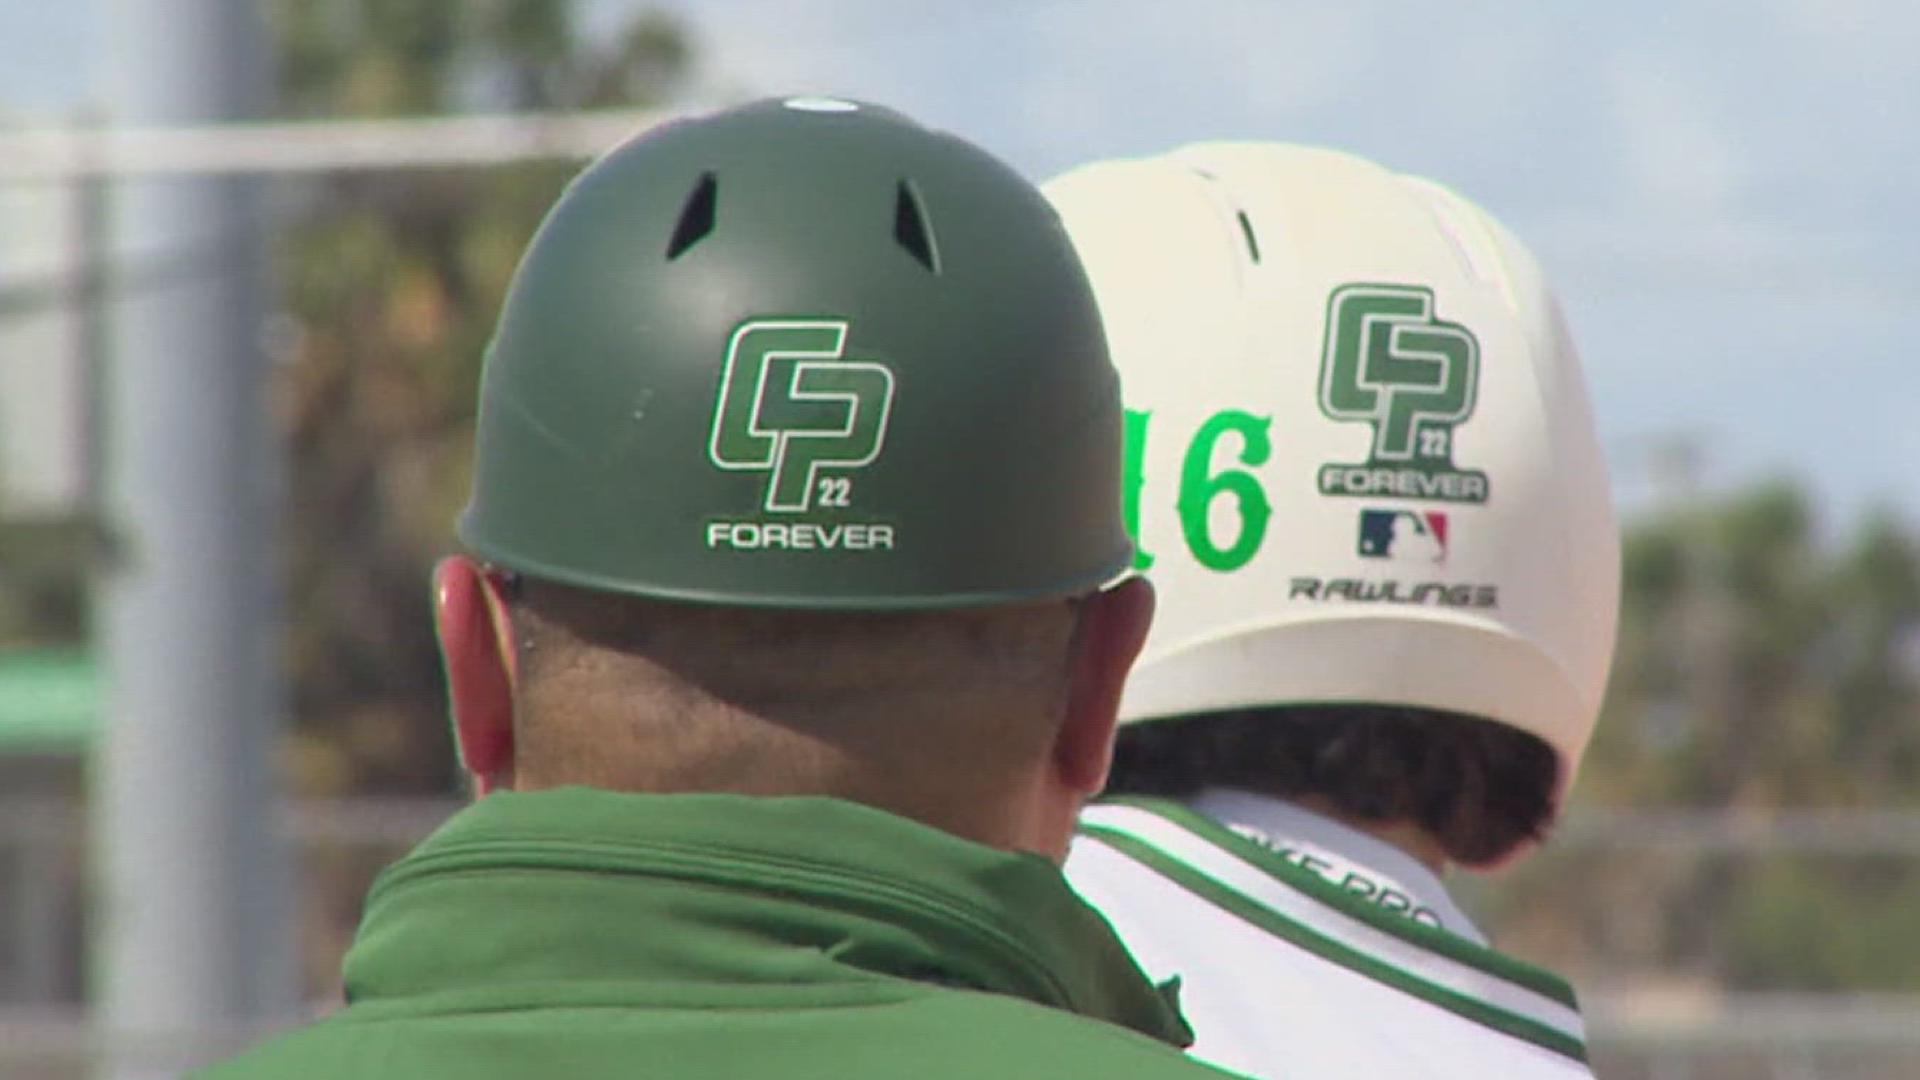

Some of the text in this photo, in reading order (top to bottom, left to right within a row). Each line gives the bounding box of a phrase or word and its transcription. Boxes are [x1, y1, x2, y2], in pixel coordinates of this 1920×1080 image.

[1321, 285, 1479, 460] CP
[710, 320, 894, 512] CP
[1420, 428, 1447, 456] 22
[818, 477, 851, 506] 22
[1322, 468, 1485, 501] FOREVER
[707, 523, 894, 549] FOREVER
[1288, 577, 1498, 607] RAWLINGS
